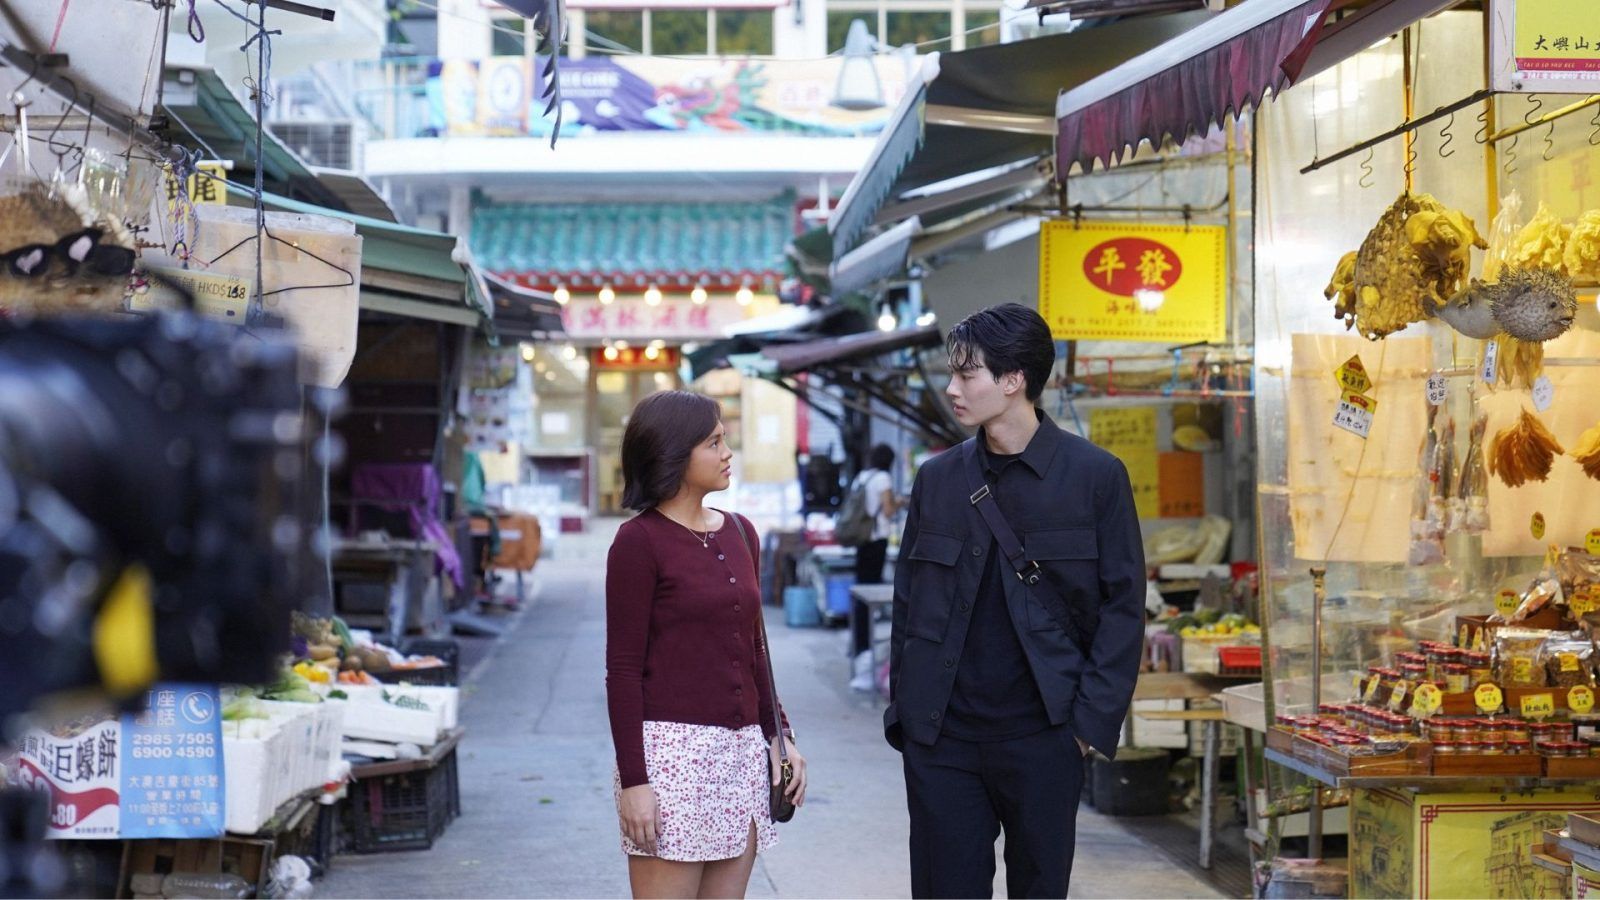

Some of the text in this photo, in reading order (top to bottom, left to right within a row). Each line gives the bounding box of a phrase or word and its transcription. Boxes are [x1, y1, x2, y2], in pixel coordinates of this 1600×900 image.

[1093, 247, 1173, 287] 平發
[132, 733, 215, 745] 2985 7505
[132, 746, 215, 758] 6900 4590
